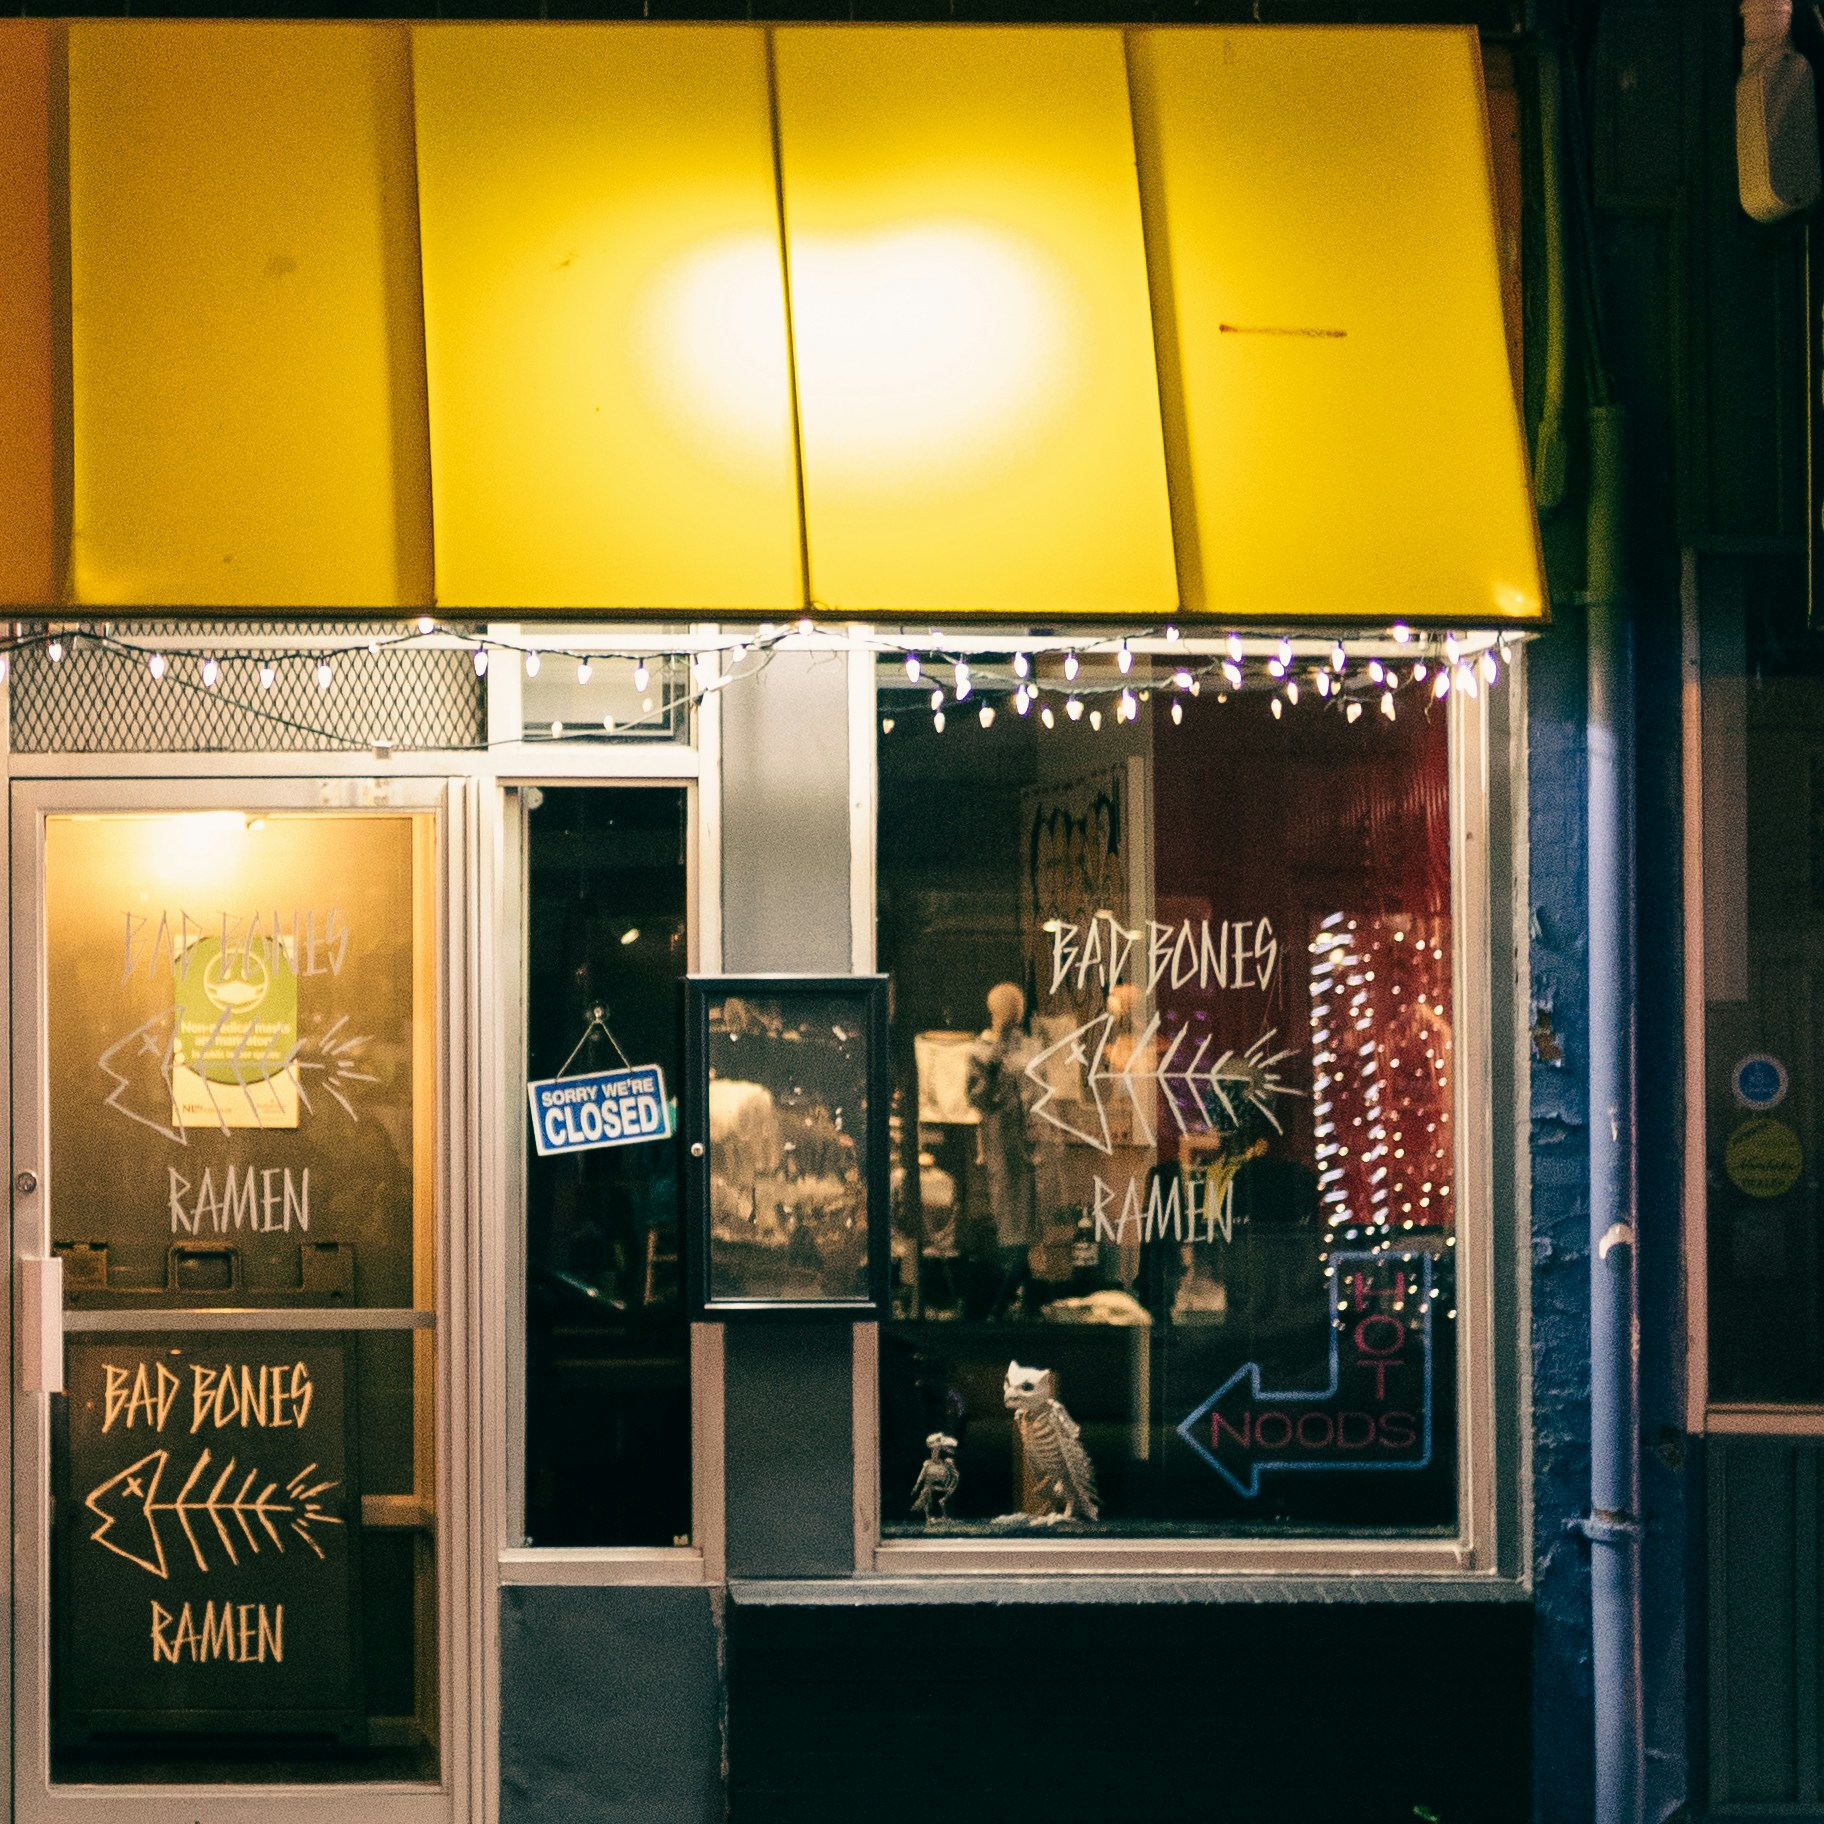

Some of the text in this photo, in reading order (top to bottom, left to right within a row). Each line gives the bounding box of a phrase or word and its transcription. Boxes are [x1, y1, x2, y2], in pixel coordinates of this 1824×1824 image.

[120, 906, 350, 987] BAD BONES
[1049, 915, 1278, 994] BAD BONES
[541, 1078, 654, 1109] SORRY WE'RE
[545, 1095, 659, 1147] CLOSED
[167, 1164, 310, 1235] RAMEN
[1092, 1175, 1233, 1245] RAMEN
[1354, 1272, 1406, 1401] HOT
[101, 1361, 314, 1434] BAD BONES
[1210, 1410, 1417, 1449] NOODS
[150, 1600, 284, 1664] RAMEN
